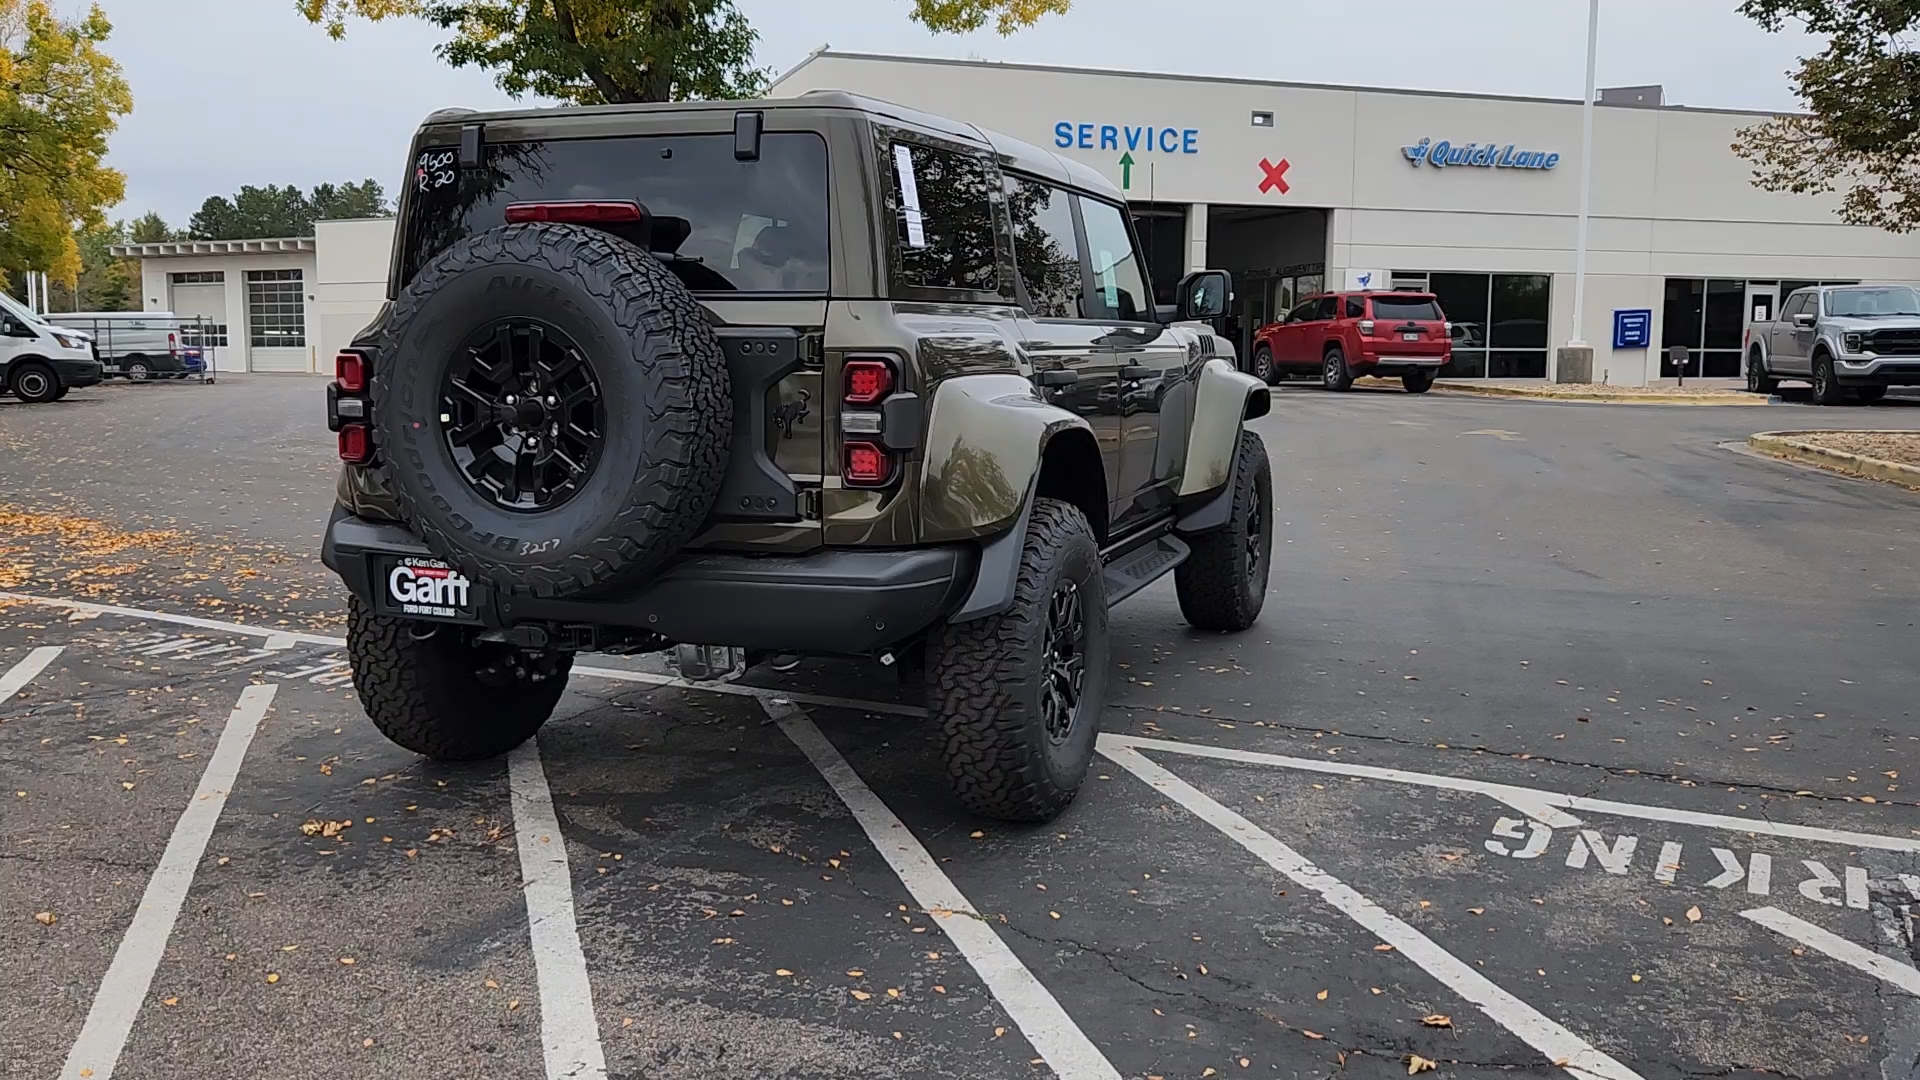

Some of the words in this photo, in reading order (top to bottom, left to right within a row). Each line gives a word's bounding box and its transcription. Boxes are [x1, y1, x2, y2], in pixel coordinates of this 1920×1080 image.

[1054, 121, 1200, 154] SERVICE
[419, 151, 454, 172] 9500
[1430, 140, 1498, 168] Quick
[1497, 143, 1561, 170] Lane
[412, 557, 429, 568] Ken
